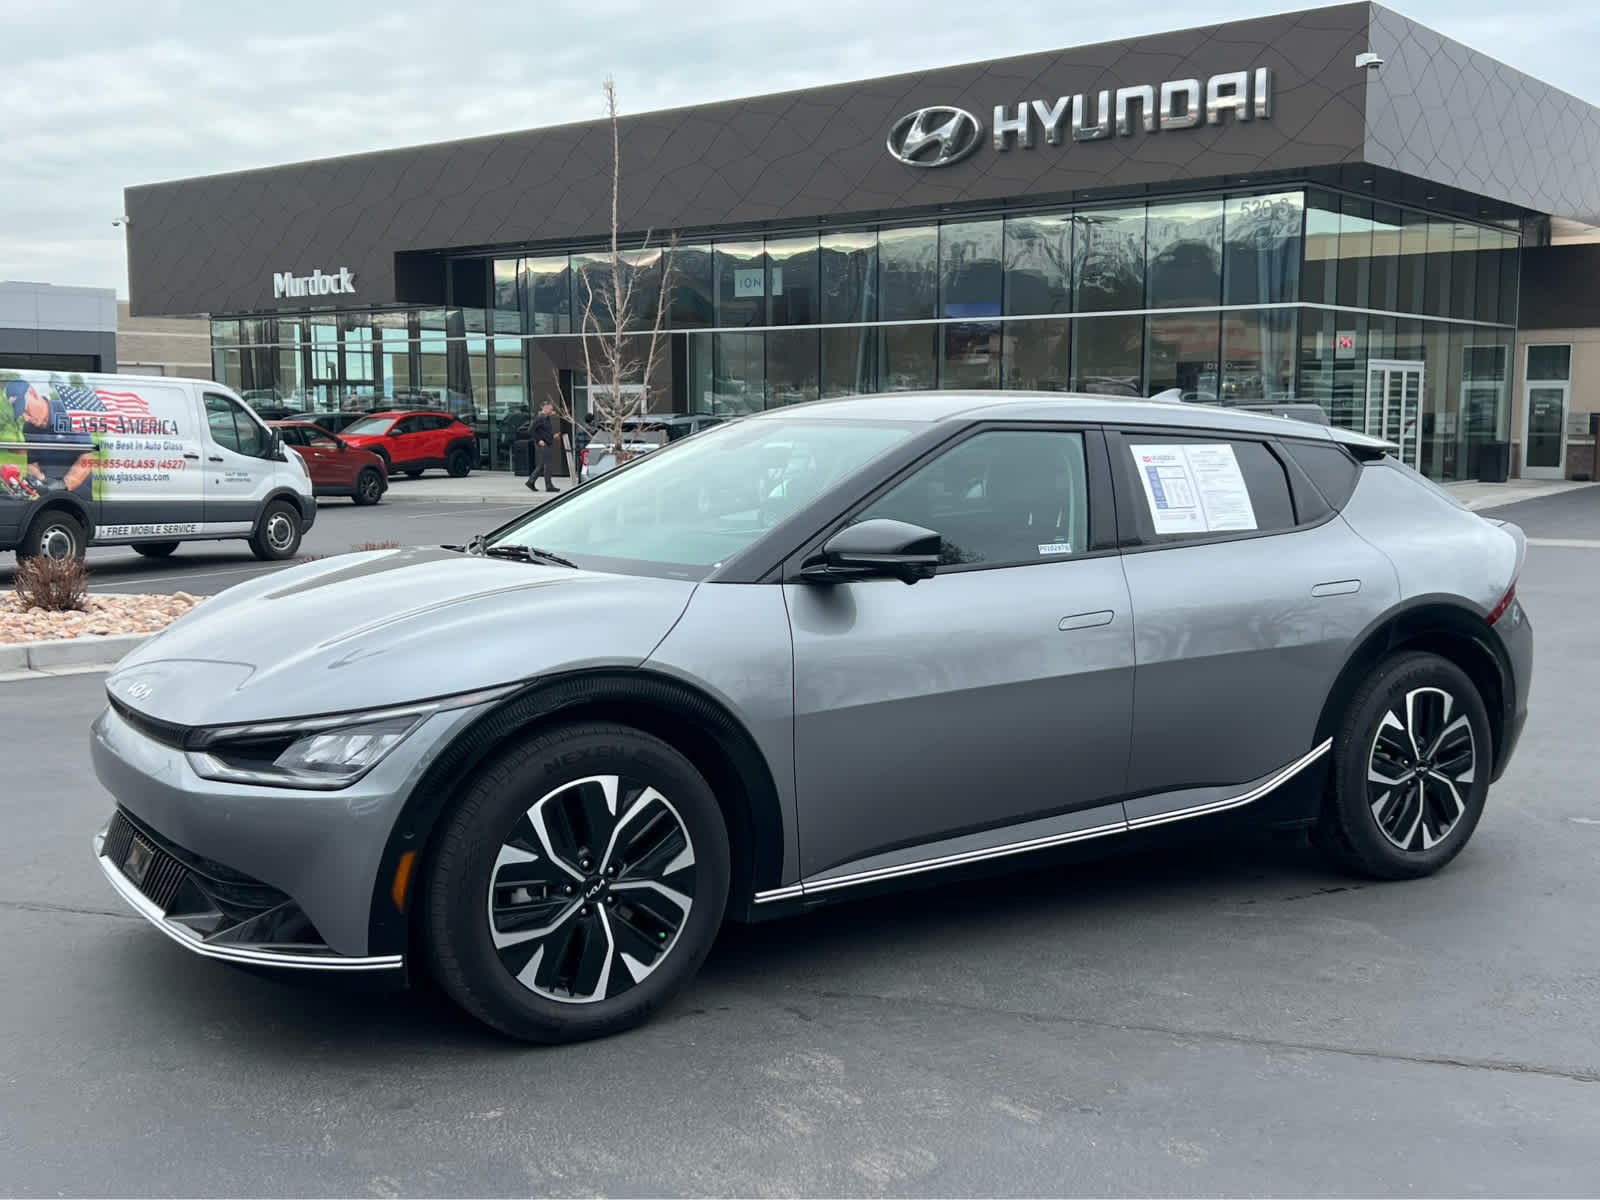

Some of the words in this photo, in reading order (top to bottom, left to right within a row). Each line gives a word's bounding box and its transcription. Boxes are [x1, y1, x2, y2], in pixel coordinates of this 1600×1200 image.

[992, 67, 1273, 151] HYUNDAI
[273, 266, 356, 299] Murdock
[54, 412, 108, 433] GLASS
[115, 415, 179, 435] AMERICA
[116, 440, 133, 450] Best
[144, 440, 162, 451] Auto
[163, 441, 184, 451] Glass
[157, 458, 187, 471] (4527)
[94, 471, 170, 484] www.glassusa.com
[107, 526, 129, 536] FREE
[131, 525, 161, 535] MOBILE
[162, 524, 196, 534] SERVICE
